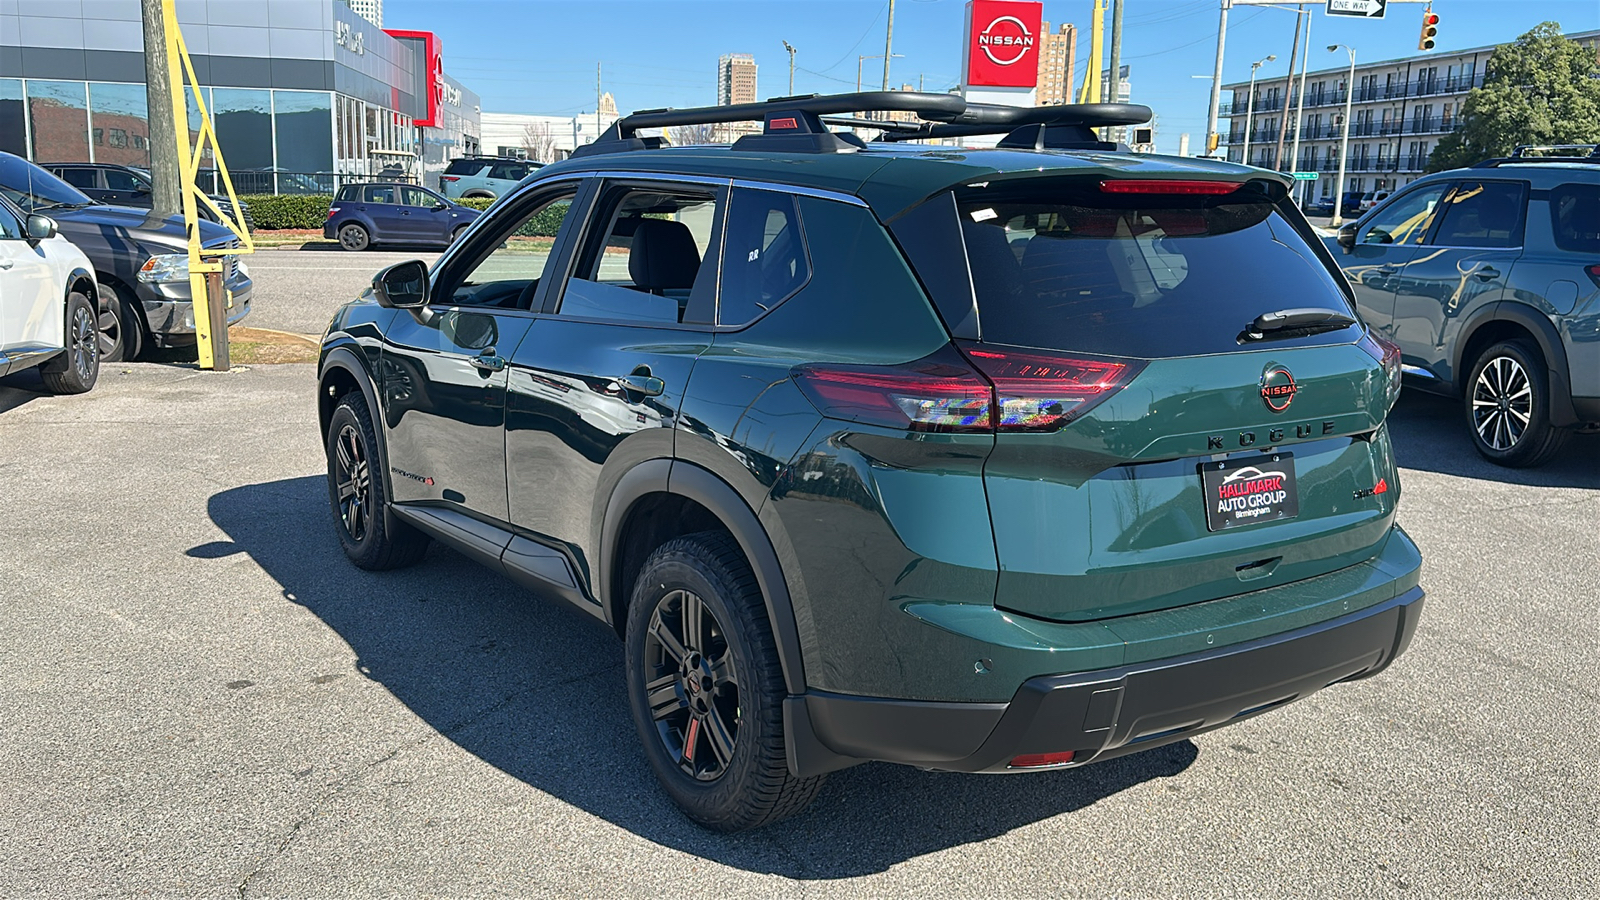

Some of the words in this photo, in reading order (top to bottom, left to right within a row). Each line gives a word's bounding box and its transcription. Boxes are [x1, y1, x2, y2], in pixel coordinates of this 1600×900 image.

[1333, 1, 1349, 9] ONE
[1353, 1, 1369, 10] WAY
[979, 35, 1034, 46] NISSAN
[748, 248, 759, 262] RR
[1261, 384, 1297, 396] NISSAN
[1207, 421, 1335, 450] ROGUE
[1218, 477, 1282, 499] HALLMARK
[1217, 496, 1247, 513] AUTO
[1248, 490, 1287, 508] GROUP
[1235, 507, 1271, 519] Birmingham
